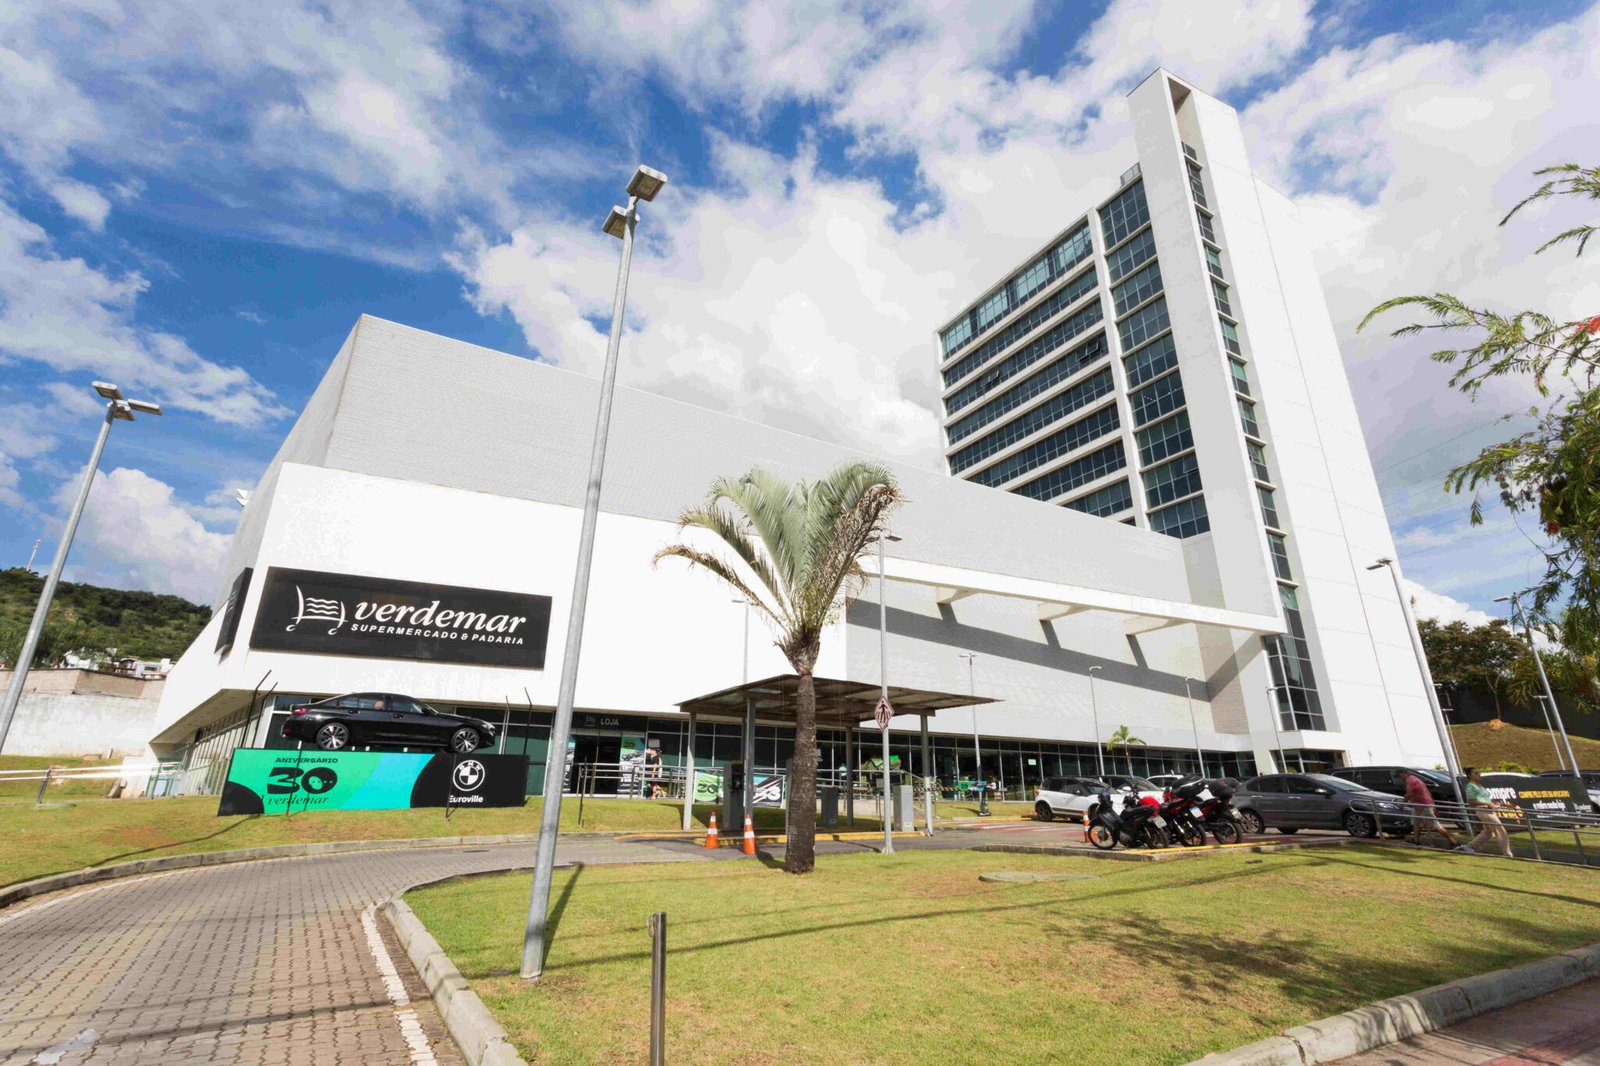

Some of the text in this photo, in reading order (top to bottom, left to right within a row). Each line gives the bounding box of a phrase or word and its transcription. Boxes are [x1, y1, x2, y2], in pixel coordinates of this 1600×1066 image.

[354, 600, 527, 633] verdemar
[351, 623, 457, 640] SUPERMERCADO
[472, 634, 523, 645] PADARIA
[600, 718, 620, 726] LOJA
[267, 767, 338, 794] 30
[449, 795, 484, 803] Euroville
[1485, 787, 1517, 804] ompre
